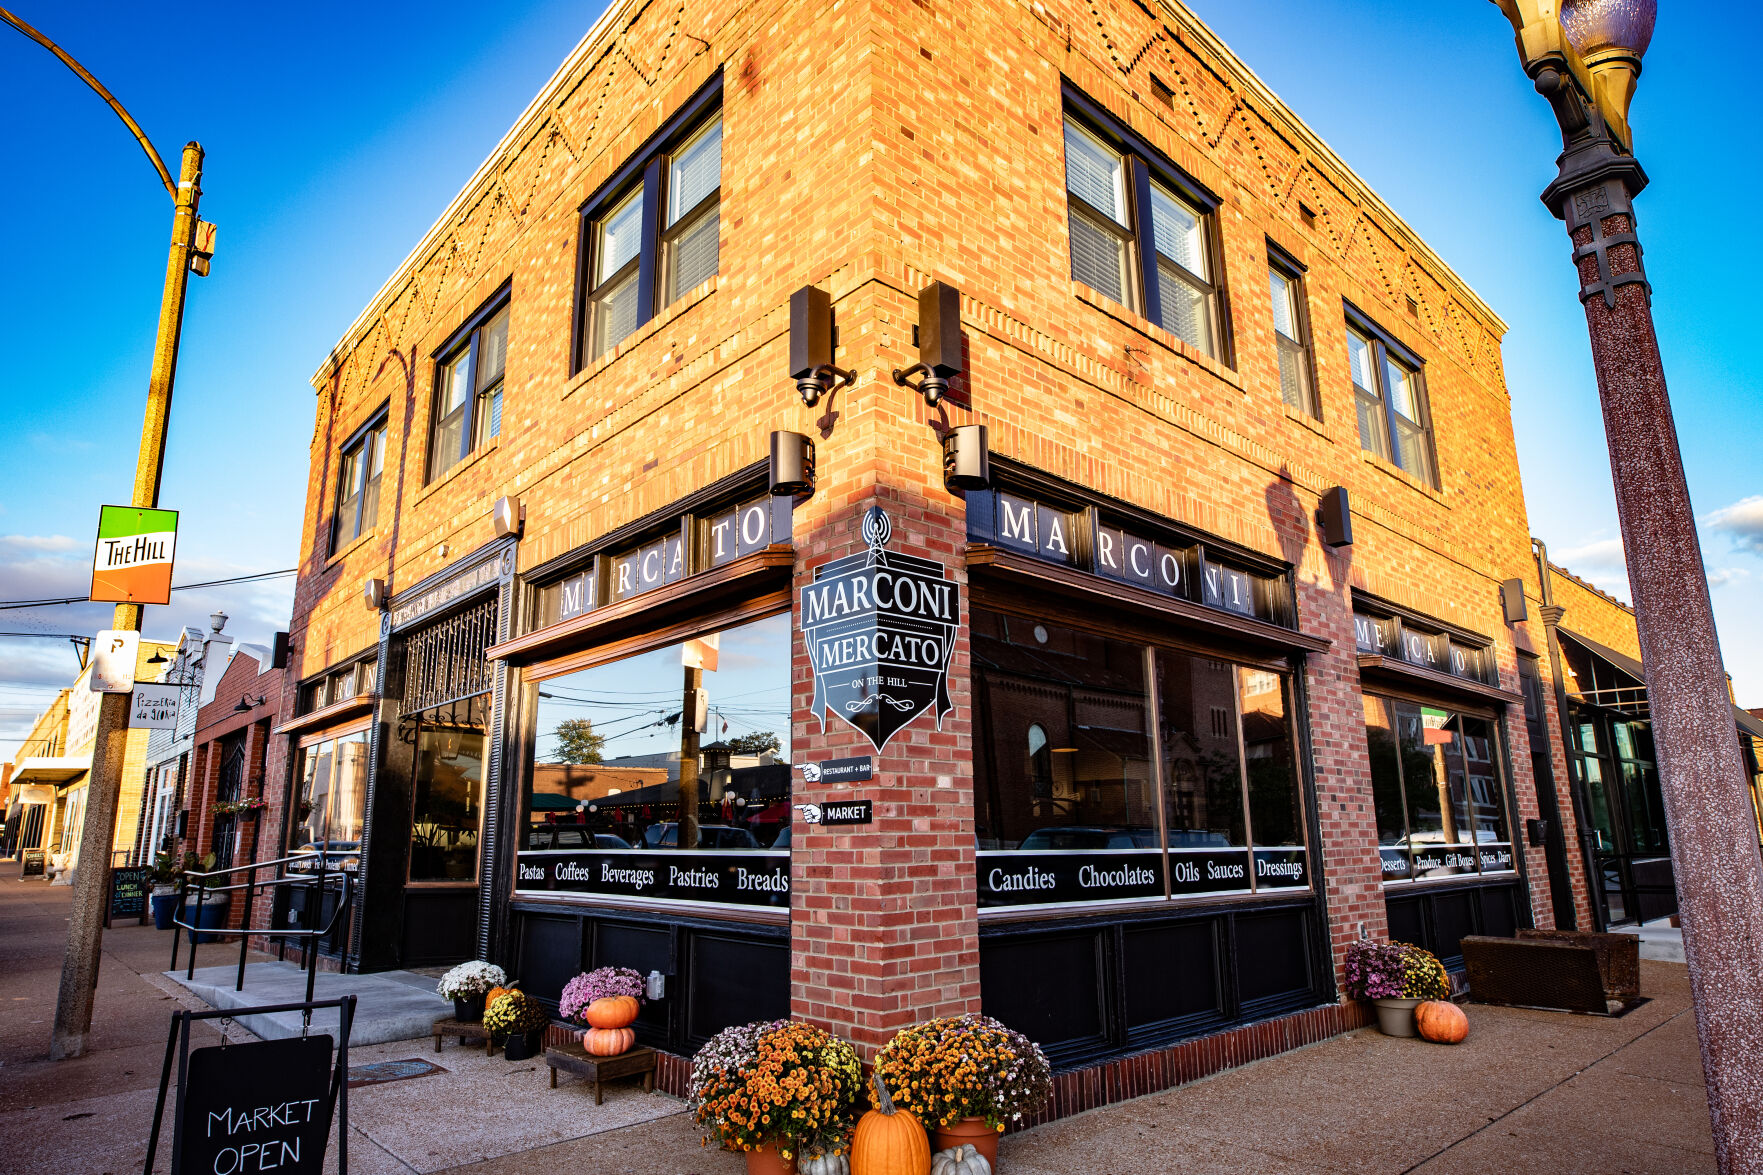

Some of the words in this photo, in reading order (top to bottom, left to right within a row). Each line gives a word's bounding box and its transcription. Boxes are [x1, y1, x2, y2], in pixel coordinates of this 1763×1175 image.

[1001, 500, 1241, 605] MARCONI
[806, 572, 952, 624] MARCONI
[821, 632, 940, 669] MERCATO
[1354, 618, 1465, 671] MECAO
[851, 678, 865, 689] ON
[866, 675, 884, 686] THE
[887, 677, 908, 688] HILL
[823, 766, 854, 776] RESTAURANT
[859, 764, 870, 772] BAR
[827, 805, 867, 820] MARKET
[988, 866, 1056, 892] Candies
[1078, 863, 1155, 888] Chocolates
[1175, 861, 1200, 882] Oils
[1207, 860, 1244, 880] Sauces
[1257, 858, 1303, 880] Dressings
[1416, 854, 1442, 870] Produce
[1445, 853, 1458, 867] Gift
[1457, 853, 1475, 867] Boxes
[1479, 851, 1496, 869] Spices
[1497, 850, 1512, 866] Dairy
[116, 883, 138, 891] LUNCH
[120, 871, 140, 881] OPEN
[519, 863, 545, 880] Pastas
[555, 862, 589, 881] Coffees
[601, 863, 654, 890] Beverages
[668, 865, 719, 888] Pastries
[736, 867, 789, 892] Breads
[121, 890, 143, 898] DINNER
[207, 1098, 320, 1138] MARKET
[213, 1136, 300, 1175] OPEN
